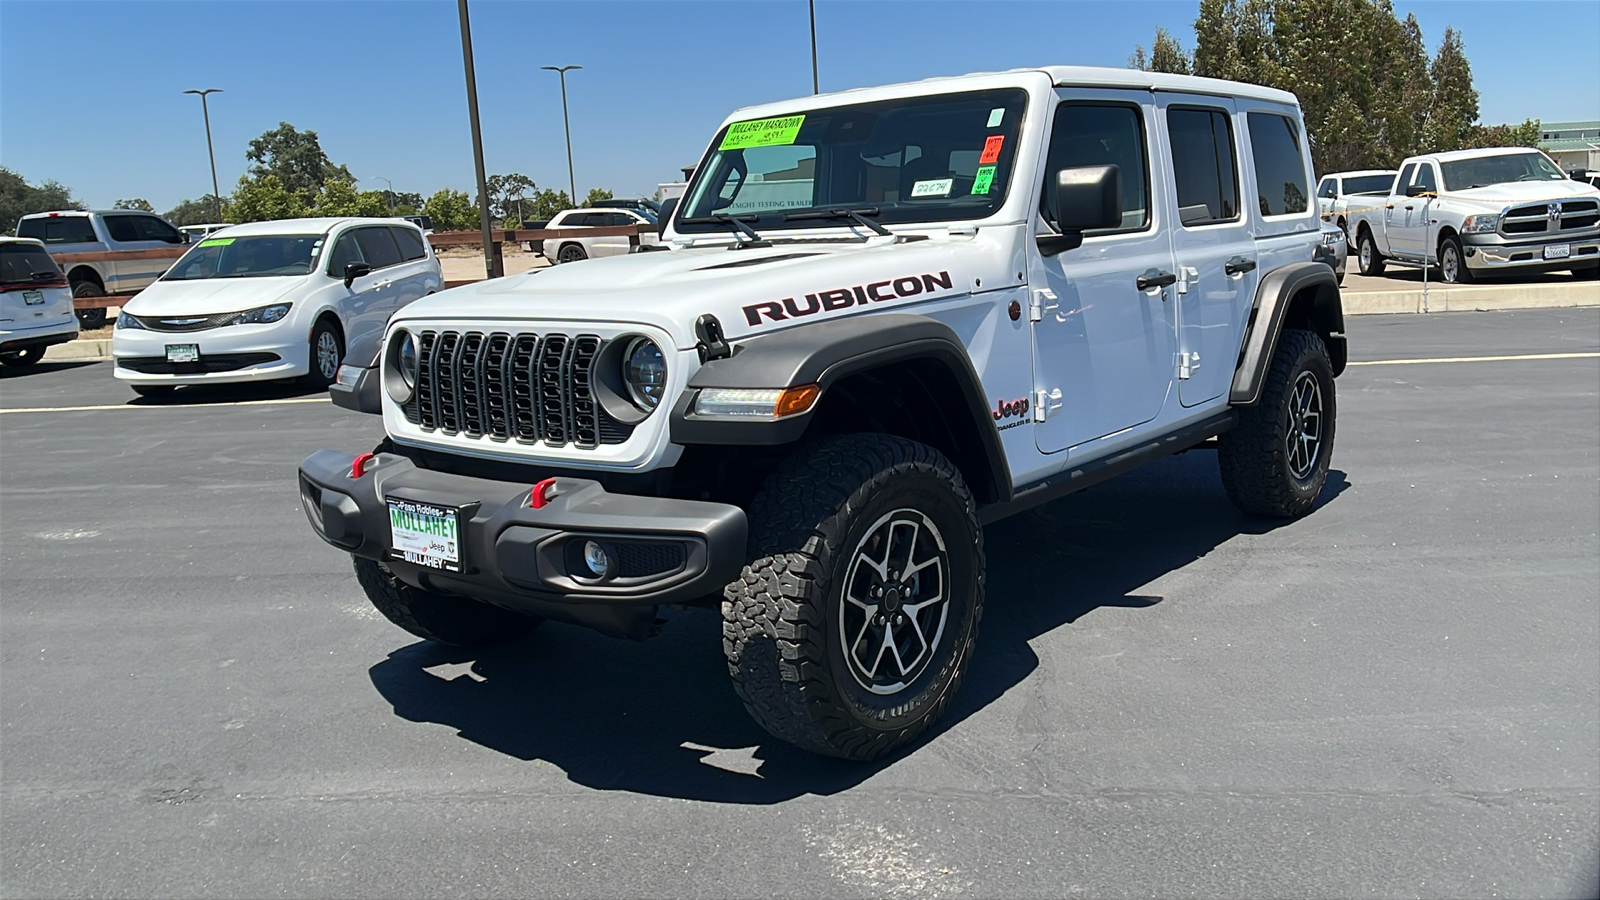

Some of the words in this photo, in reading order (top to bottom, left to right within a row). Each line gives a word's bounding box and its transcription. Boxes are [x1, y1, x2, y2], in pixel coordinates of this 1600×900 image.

[741, 270, 953, 327] RUBICON
[992, 398, 1029, 421] Jeep
[399, 502, 416, 513] Paso
[416, 504, 440, 517] Robles
[391, 509, 455, 539] MULLAHEY
[428, 540, 446, 553] Jeep
[404, 551, 443, 570] MULLAHEY
